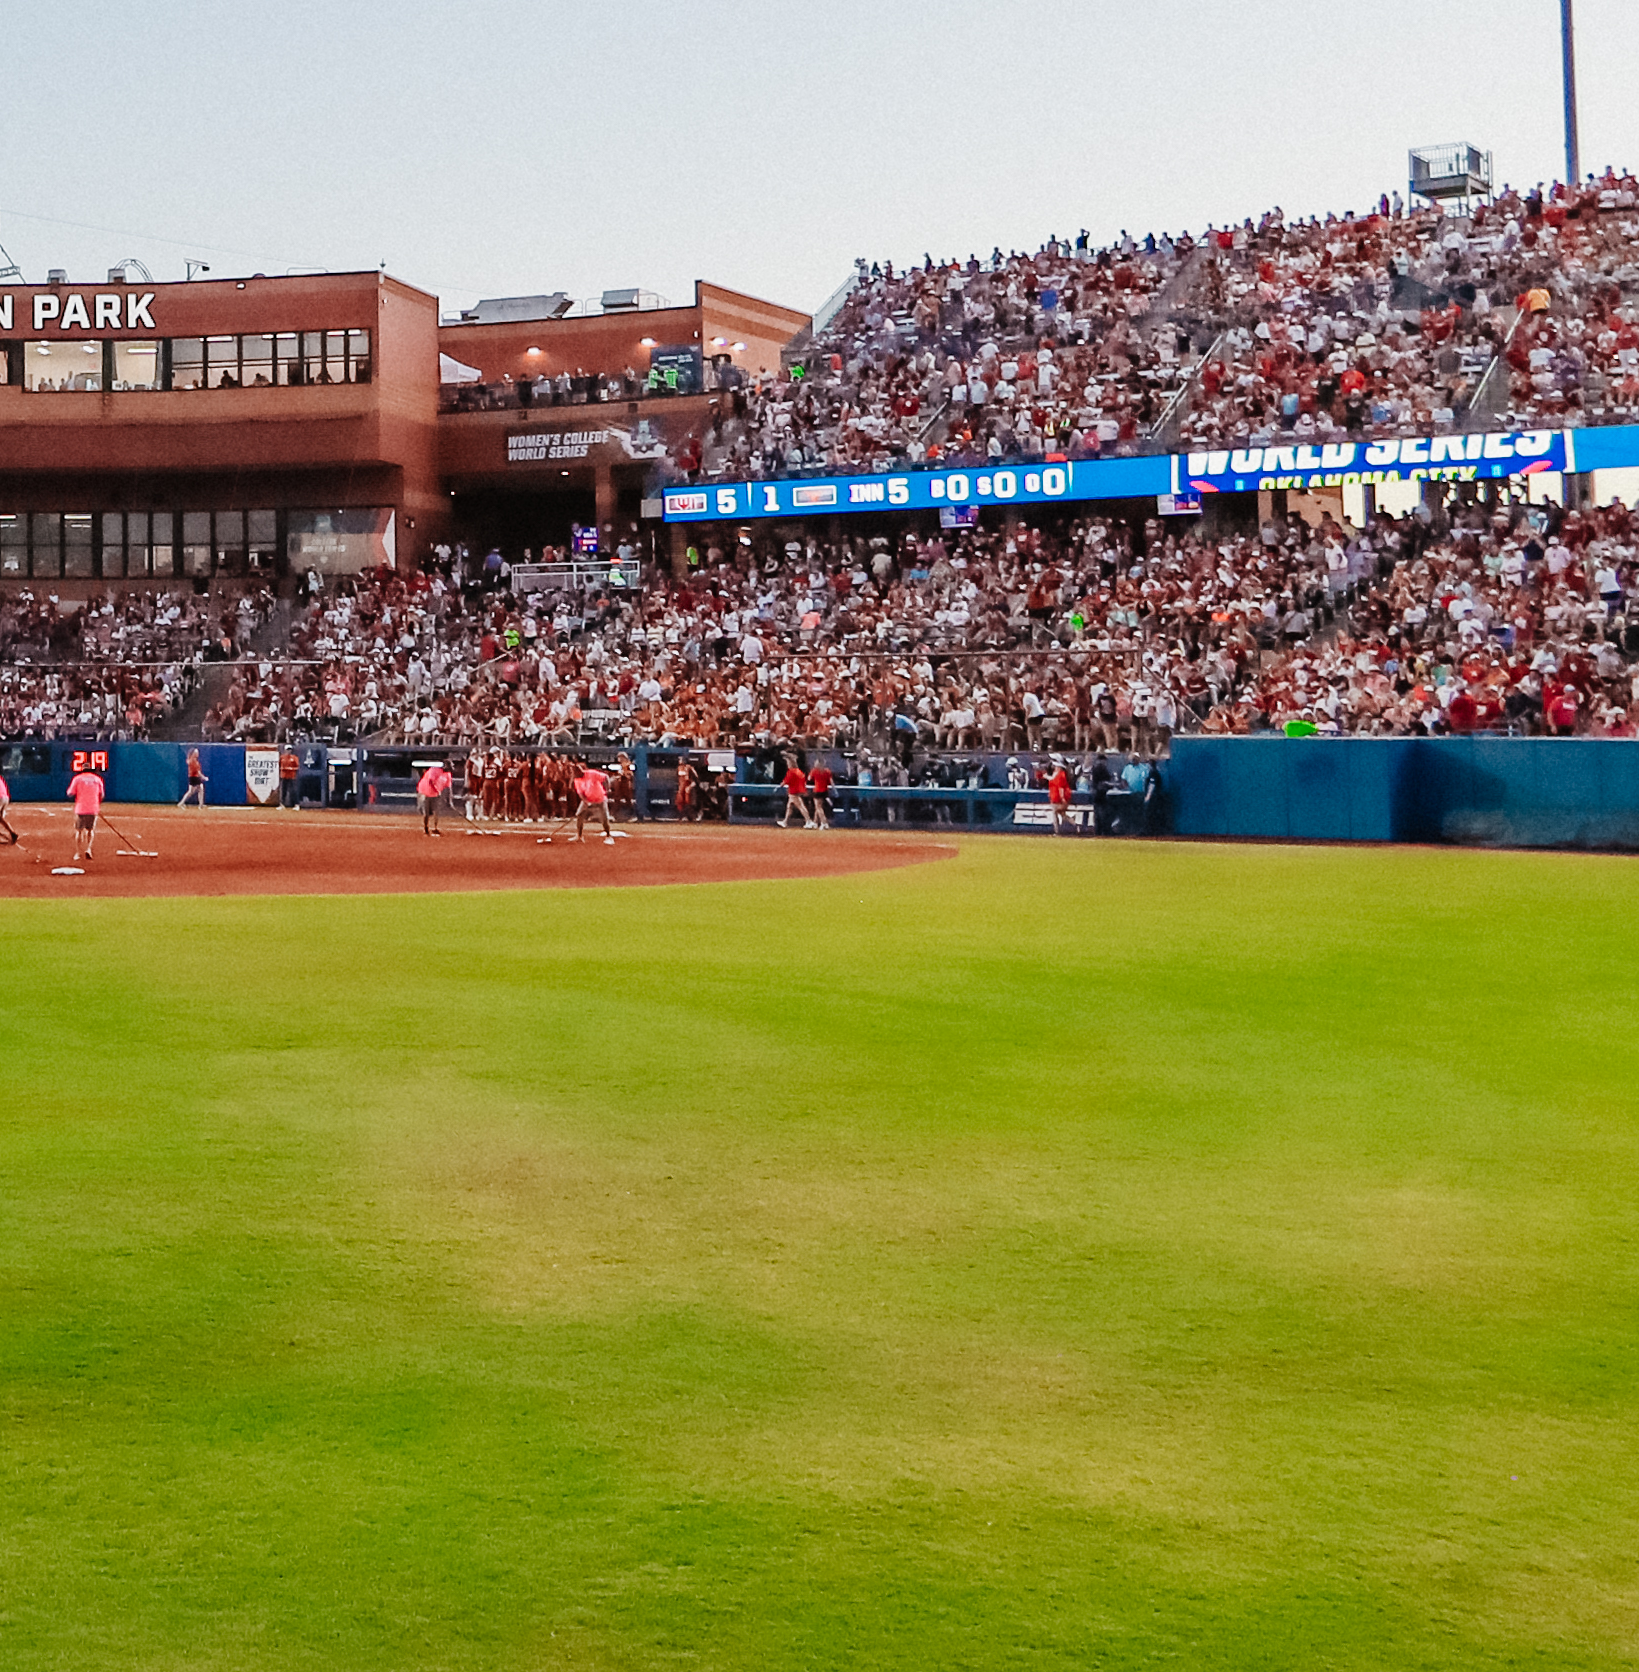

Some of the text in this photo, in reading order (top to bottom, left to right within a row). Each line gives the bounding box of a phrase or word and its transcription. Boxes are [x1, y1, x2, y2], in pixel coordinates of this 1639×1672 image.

[33, 293, 156, 329] PARK
[508, 430, 609, 448] WOMEN'S COLLEGE
[508, 445, 589, 461] WORLD SERIES
[717, 488, 737, 513] 5
[762, 486, 780, 511] 1
[849, 482, 884, 503] INN
[888, 477, 909, 504] 5
[930, 479, 945, 498] B
[947, 474, 969, 500] 0
[977, 476, 992, 496] S
[993, 471, 1017, 499] 0
